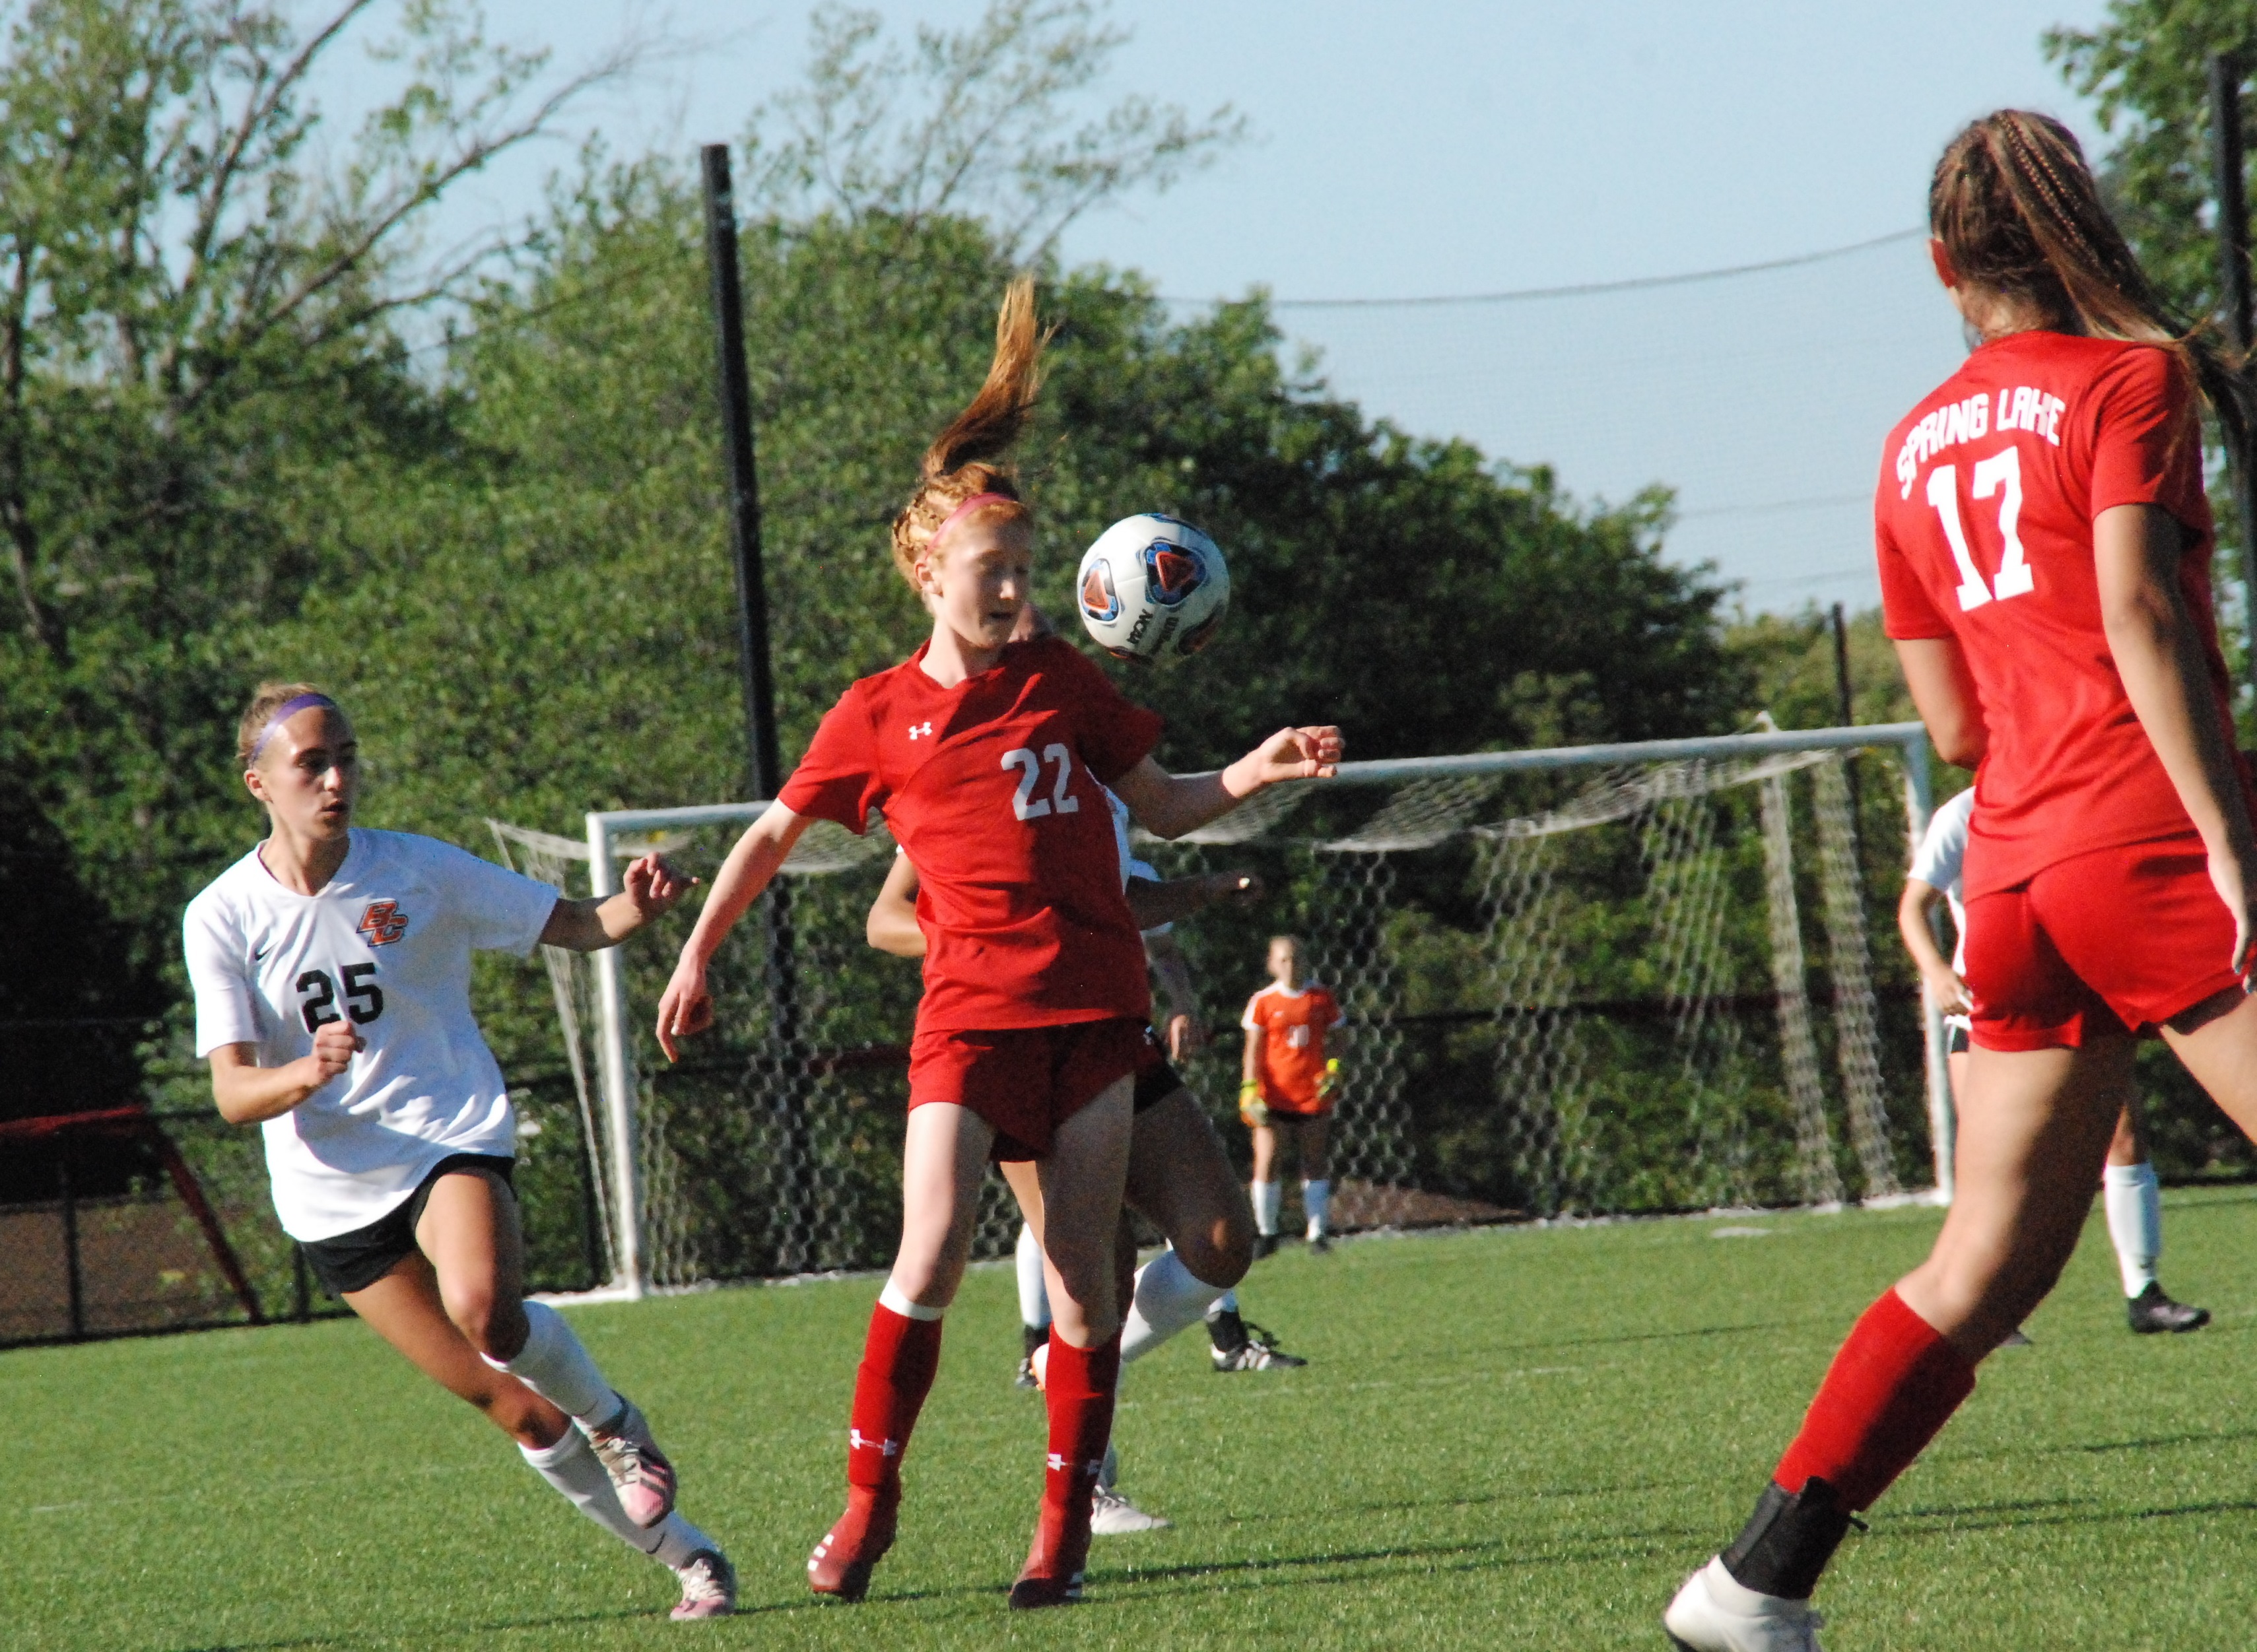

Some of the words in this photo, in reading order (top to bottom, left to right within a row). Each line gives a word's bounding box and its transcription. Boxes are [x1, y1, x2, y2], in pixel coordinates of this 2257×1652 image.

[1896, 393, 1989, 500] SPRING
[1996, 386, 2066, 446] LAKE
[1926, 446, 2035, 612] 17
[1000, 743, 1079, 821] 22
[355, 899, 409, 947] BC
[296, 962, 384, 1034] 25
